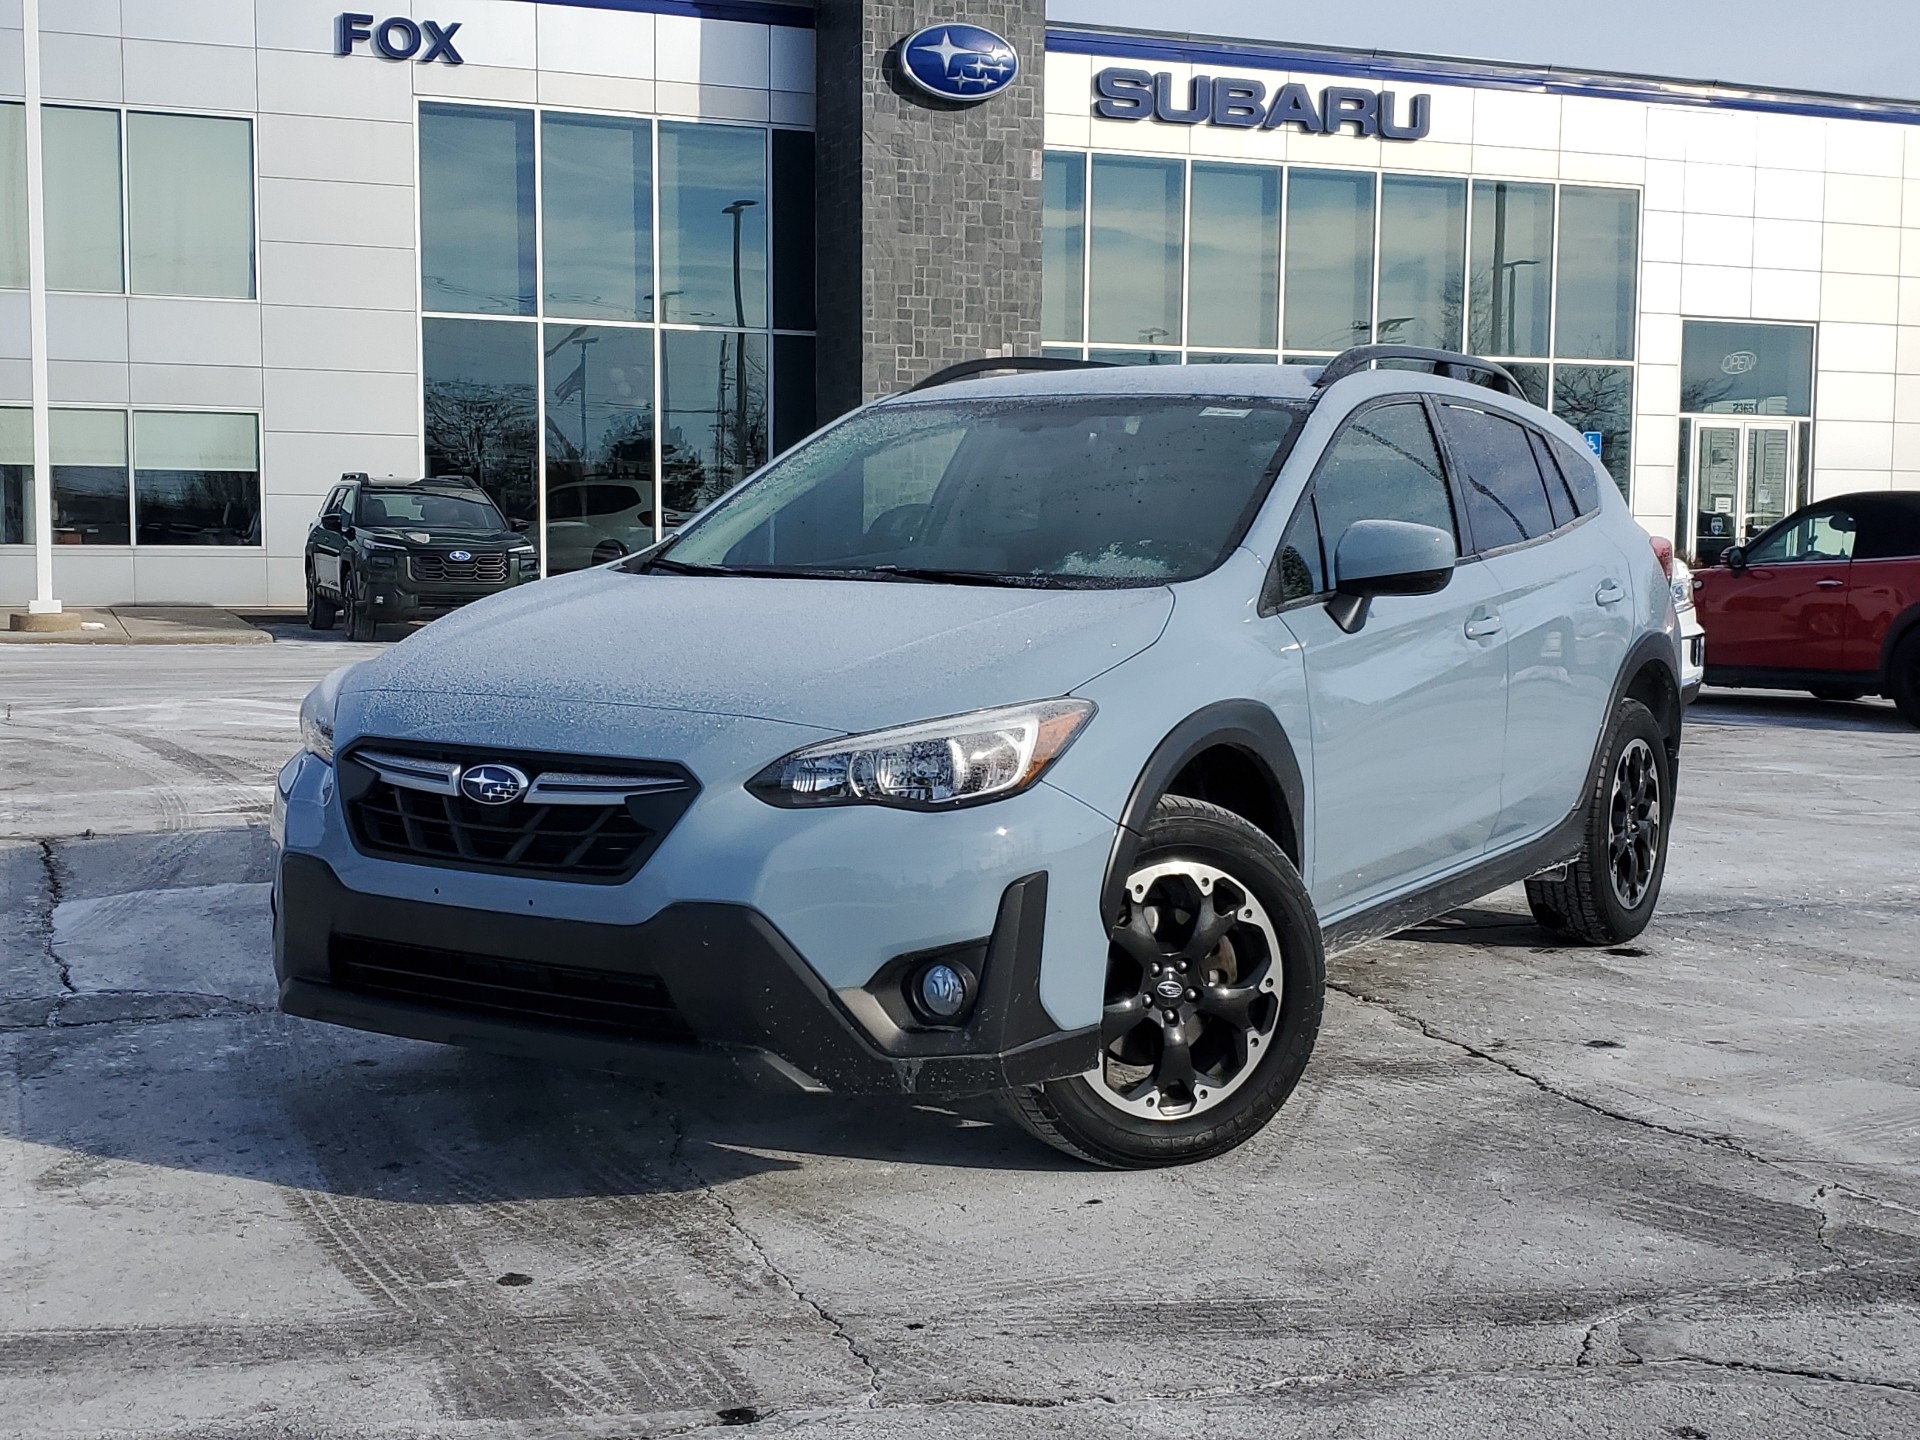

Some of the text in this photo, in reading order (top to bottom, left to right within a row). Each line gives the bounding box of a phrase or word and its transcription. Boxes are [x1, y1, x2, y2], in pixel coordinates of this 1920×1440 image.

[338, 12, 464, 65] FOX
[1093, 67, 1431, 139] SUBARU
[1722, 355, 1754, 370] OPEN
[1733, 403, 1754, 413] 2365
